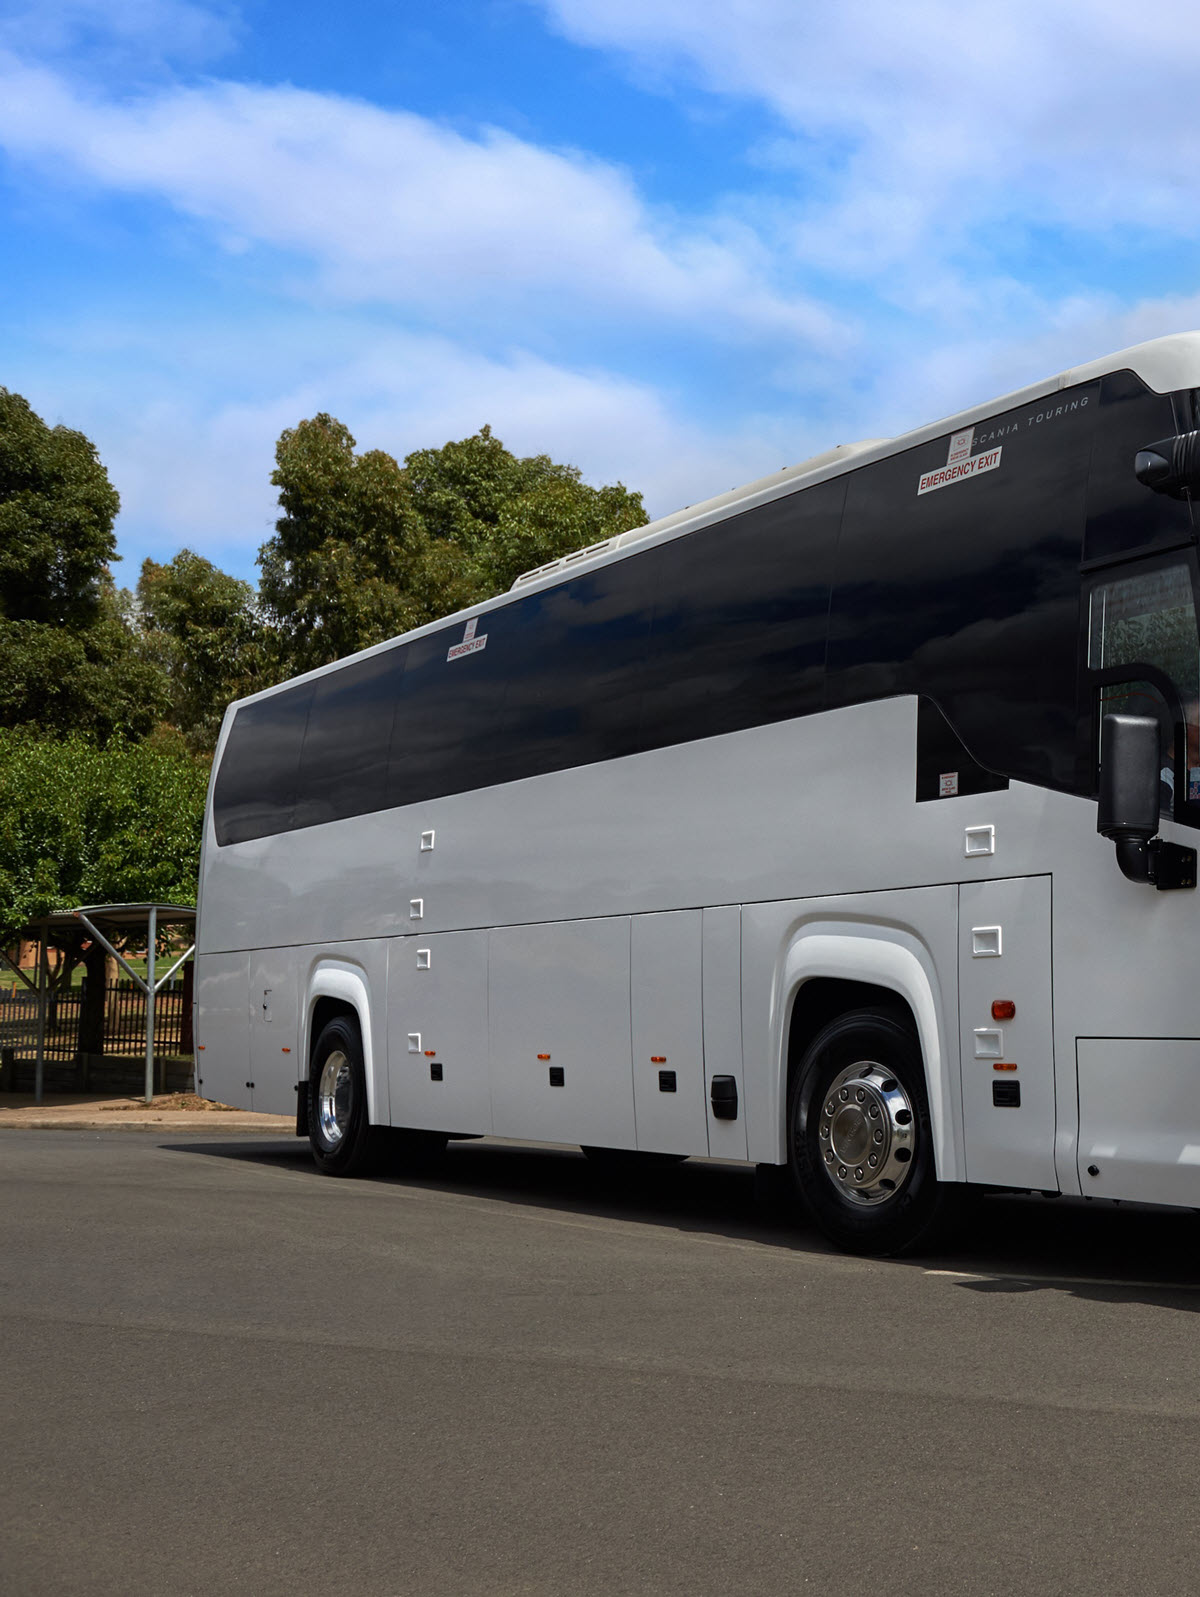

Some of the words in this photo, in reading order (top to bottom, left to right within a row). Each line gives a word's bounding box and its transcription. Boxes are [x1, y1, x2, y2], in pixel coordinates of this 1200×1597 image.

[972, 423, 1019, 447] SCANIA
[1028, 397, 1089, 426] TOURING
[920, 460, 977, 490] EMERGENCY
[977, 451, 1000, 470] EXIT
